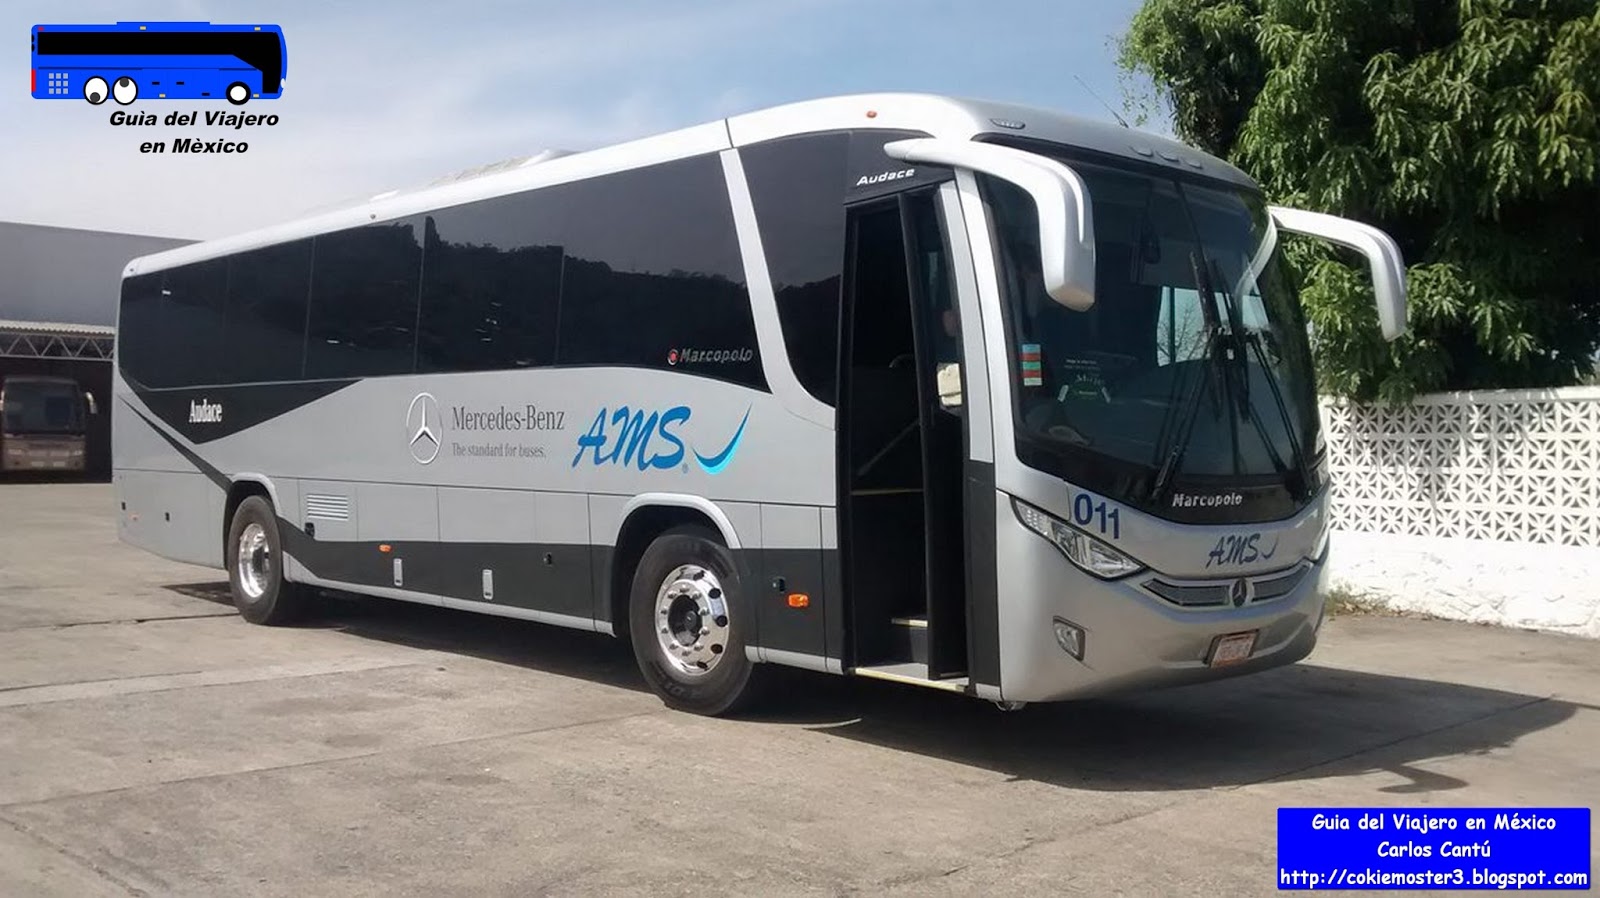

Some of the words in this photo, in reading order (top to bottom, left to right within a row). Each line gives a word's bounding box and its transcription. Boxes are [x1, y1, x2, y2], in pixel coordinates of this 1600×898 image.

[856, 168, 916, 186] Audace
[679, 346, 754, 364] Marcopolo
[188, 399, 223, 423] Audace
[452, 404, 565, 431] Mercedes-Benz
[572, 405, 692, 471] AMS
[452, 442, 465, 456] The
[468, 442, 503, 457] standard
[504, 443, 517, 457] for
[519, 444, 546, 459] buses.
[1172, 493, 1243, 508] Marcopolo
[1074, 494, 1120, 540] 011
[1205, 533, 1261, 569] AMS
